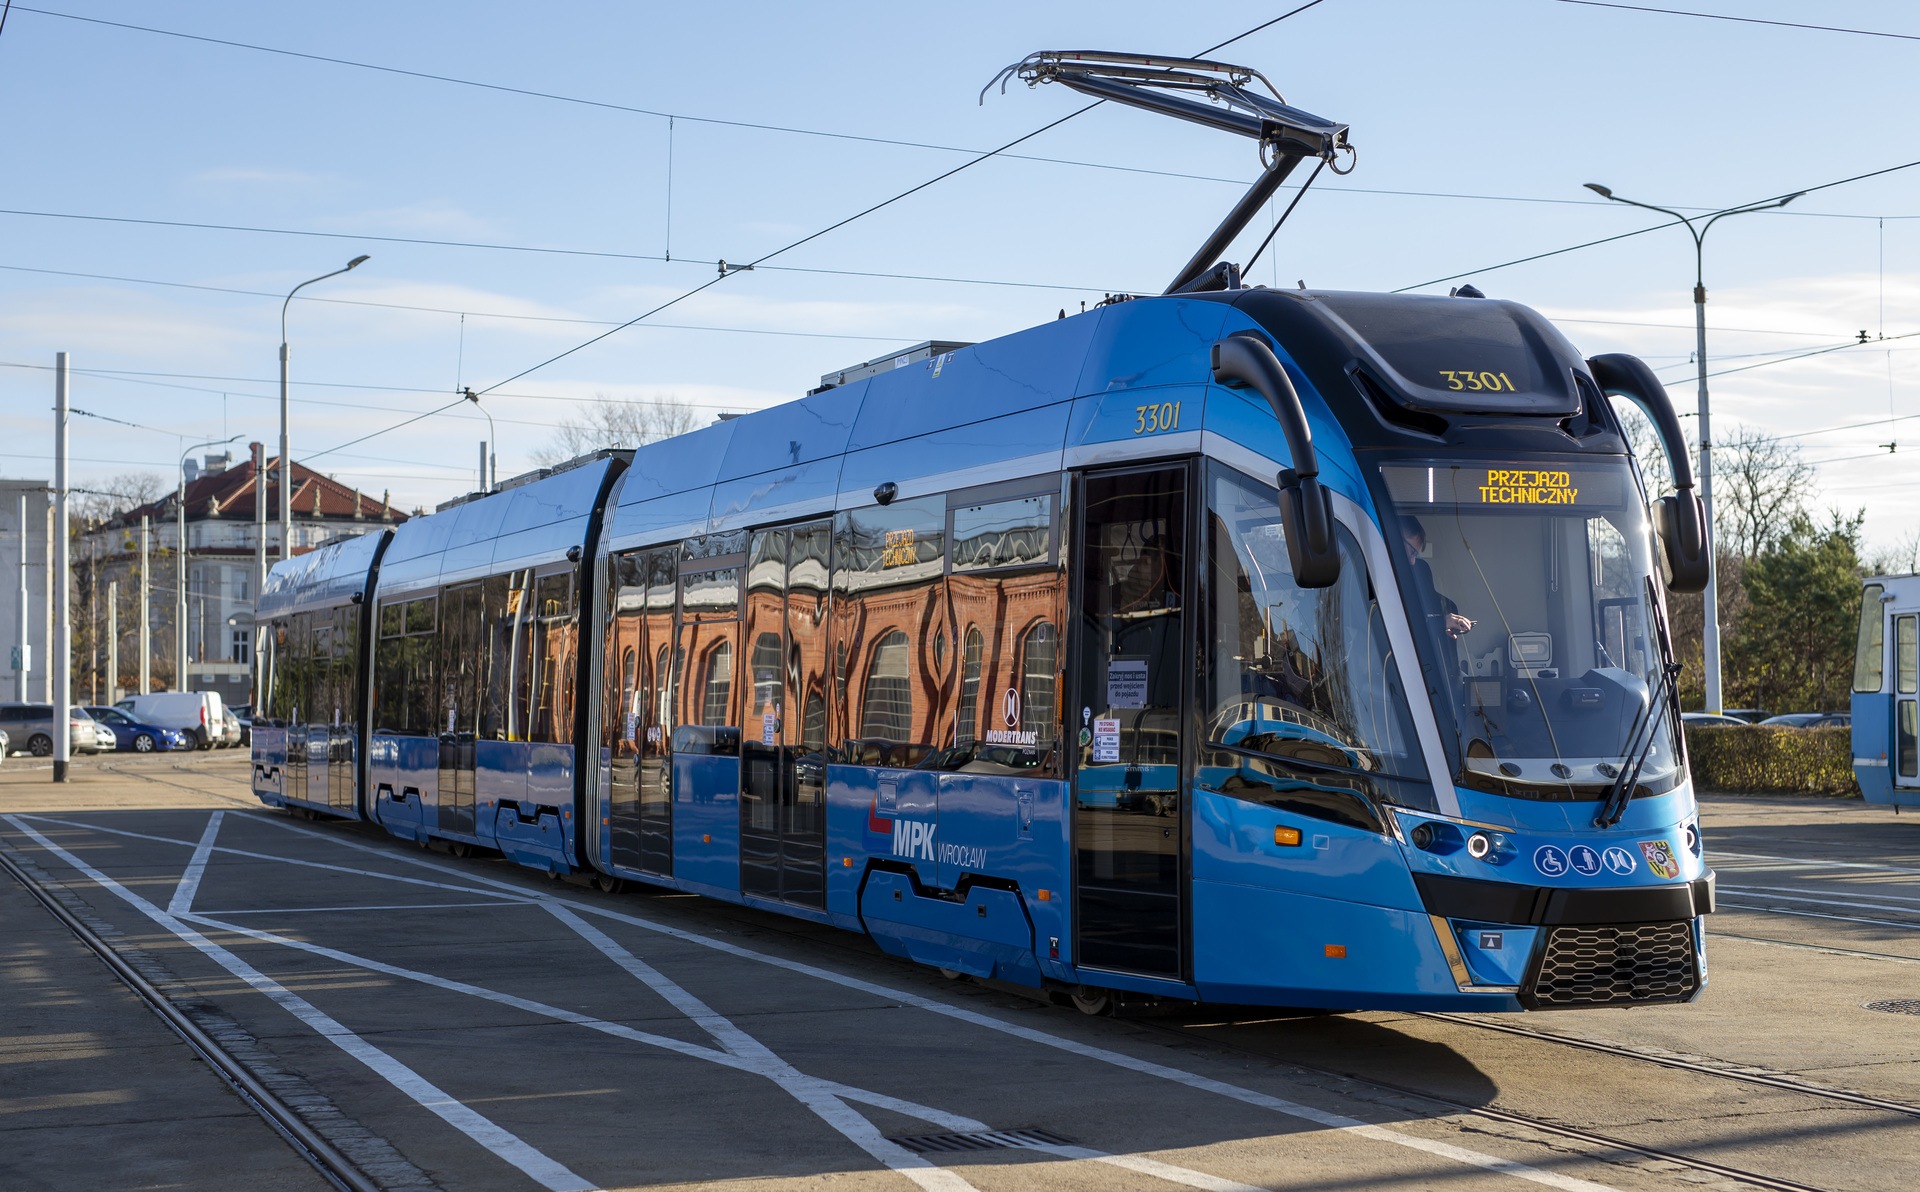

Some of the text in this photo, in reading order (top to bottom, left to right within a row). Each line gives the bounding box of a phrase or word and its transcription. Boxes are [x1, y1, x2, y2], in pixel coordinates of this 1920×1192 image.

[1438, 370, 1516, 392] 3301
[1134, 400, 1181, 435] 3301
[1487, 469, 1570, 487] PRZEJAZD
[1478, 486, 1578, 504] TECHNICZNY
[1109, 672, 1124, 681] Zakryj
[986, 730, 1036, 744] MODERTRANS
[893, 819, 987, 870] MPK WROCŁAW
